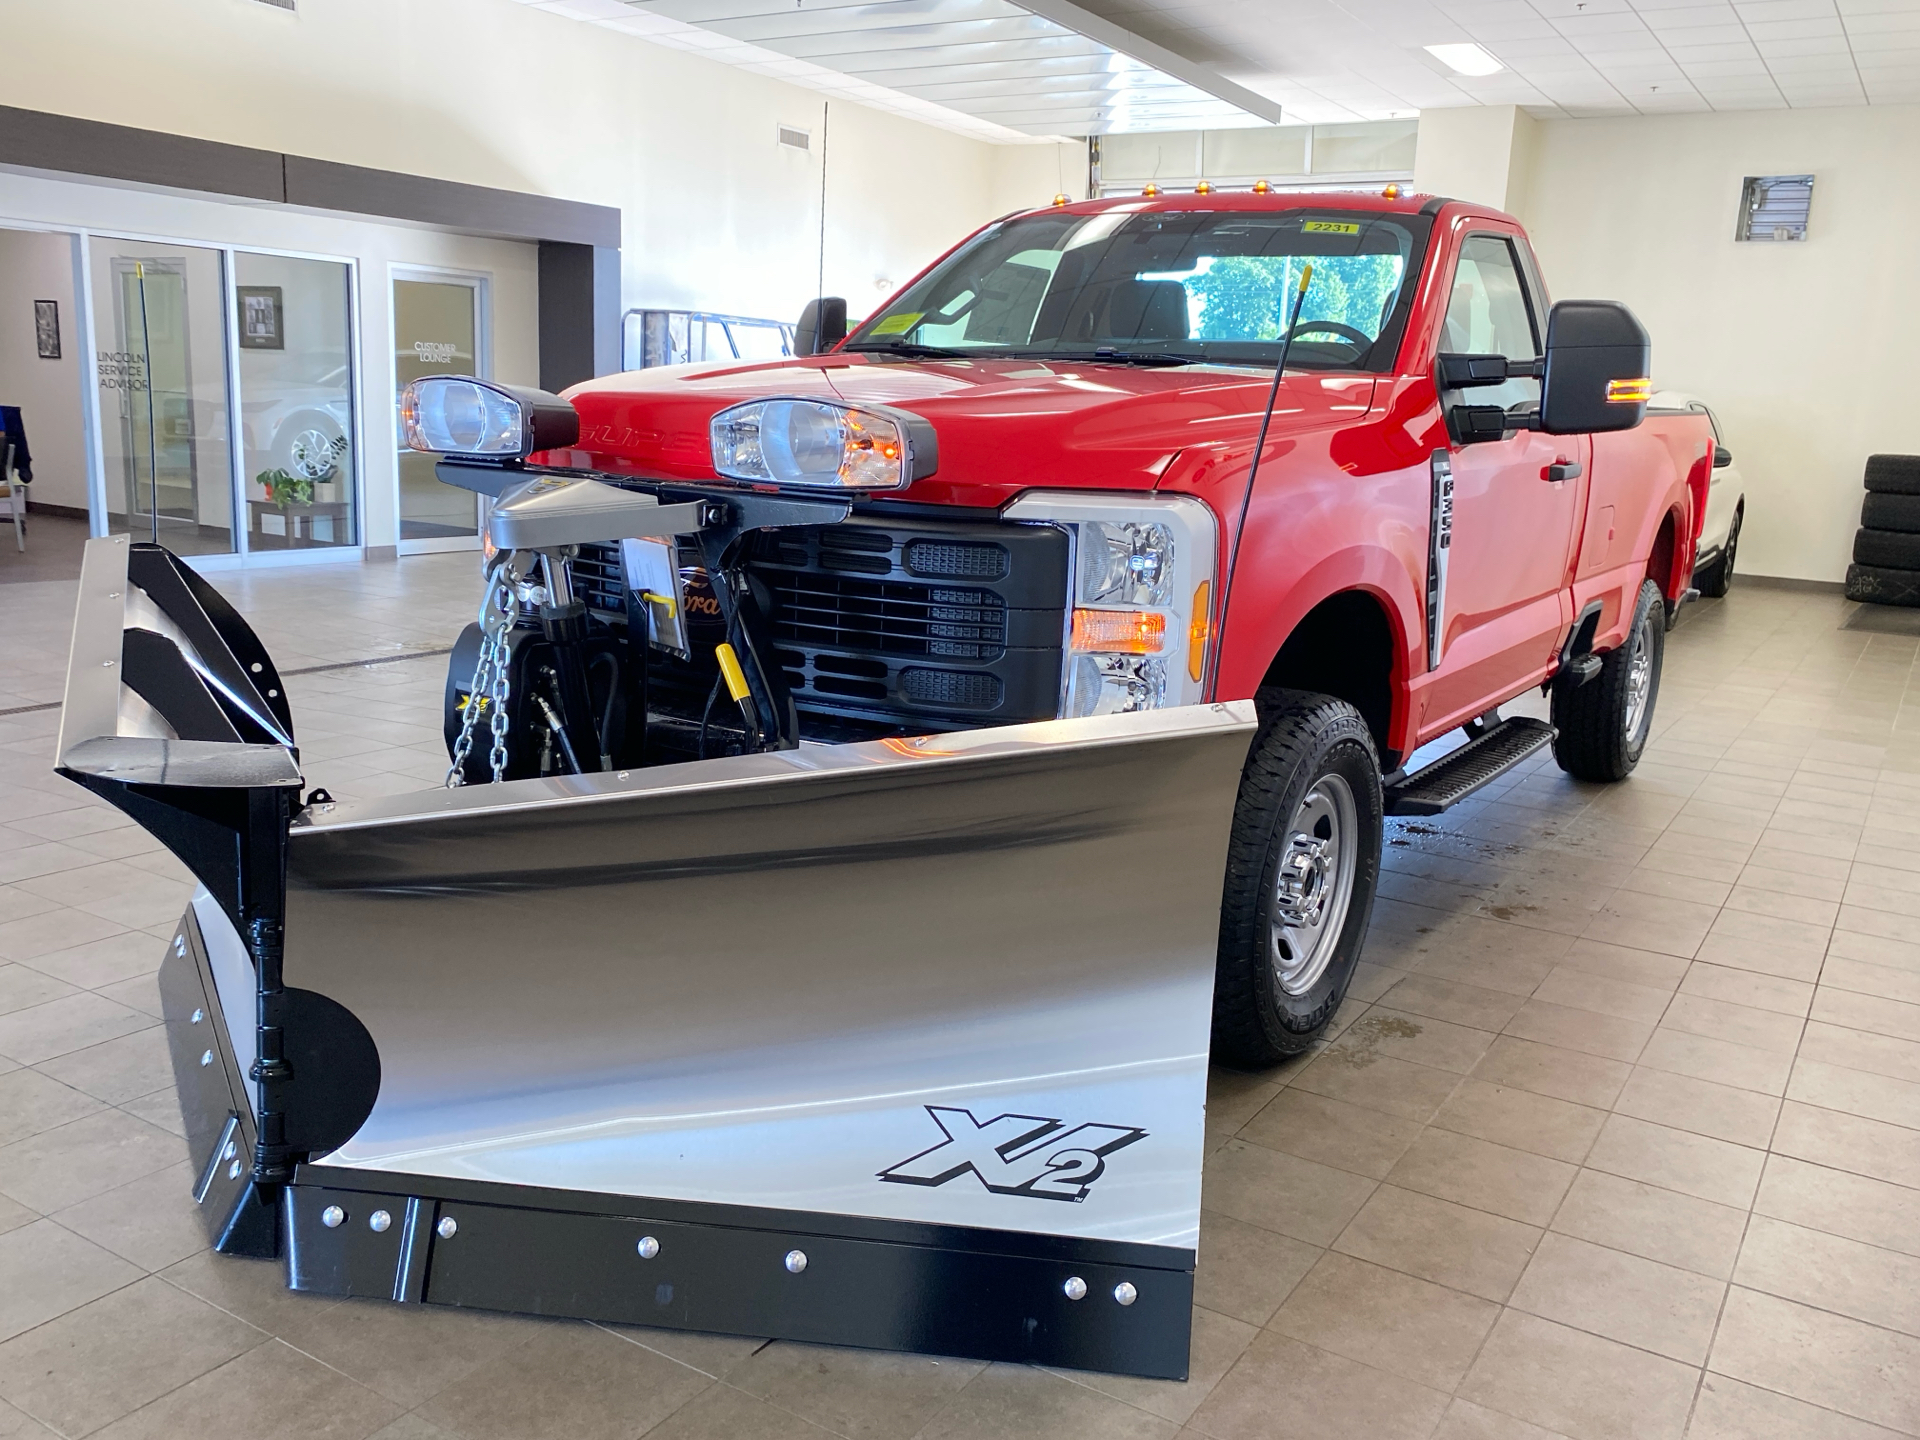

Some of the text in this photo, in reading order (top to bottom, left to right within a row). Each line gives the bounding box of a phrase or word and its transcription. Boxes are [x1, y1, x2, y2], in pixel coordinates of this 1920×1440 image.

[1312, 223, 1350, 232] 2231
[414, 341, 456, 352] CUSTOMER
[97, 352, 145, 363] LINCOLN
[419, 352, 452, 363] LOUNGE
[98, 365, 142, 376] SERVICE
[100, 379, 148, 390] ADVISOR
[577, 424, 704, 453] SUPE
